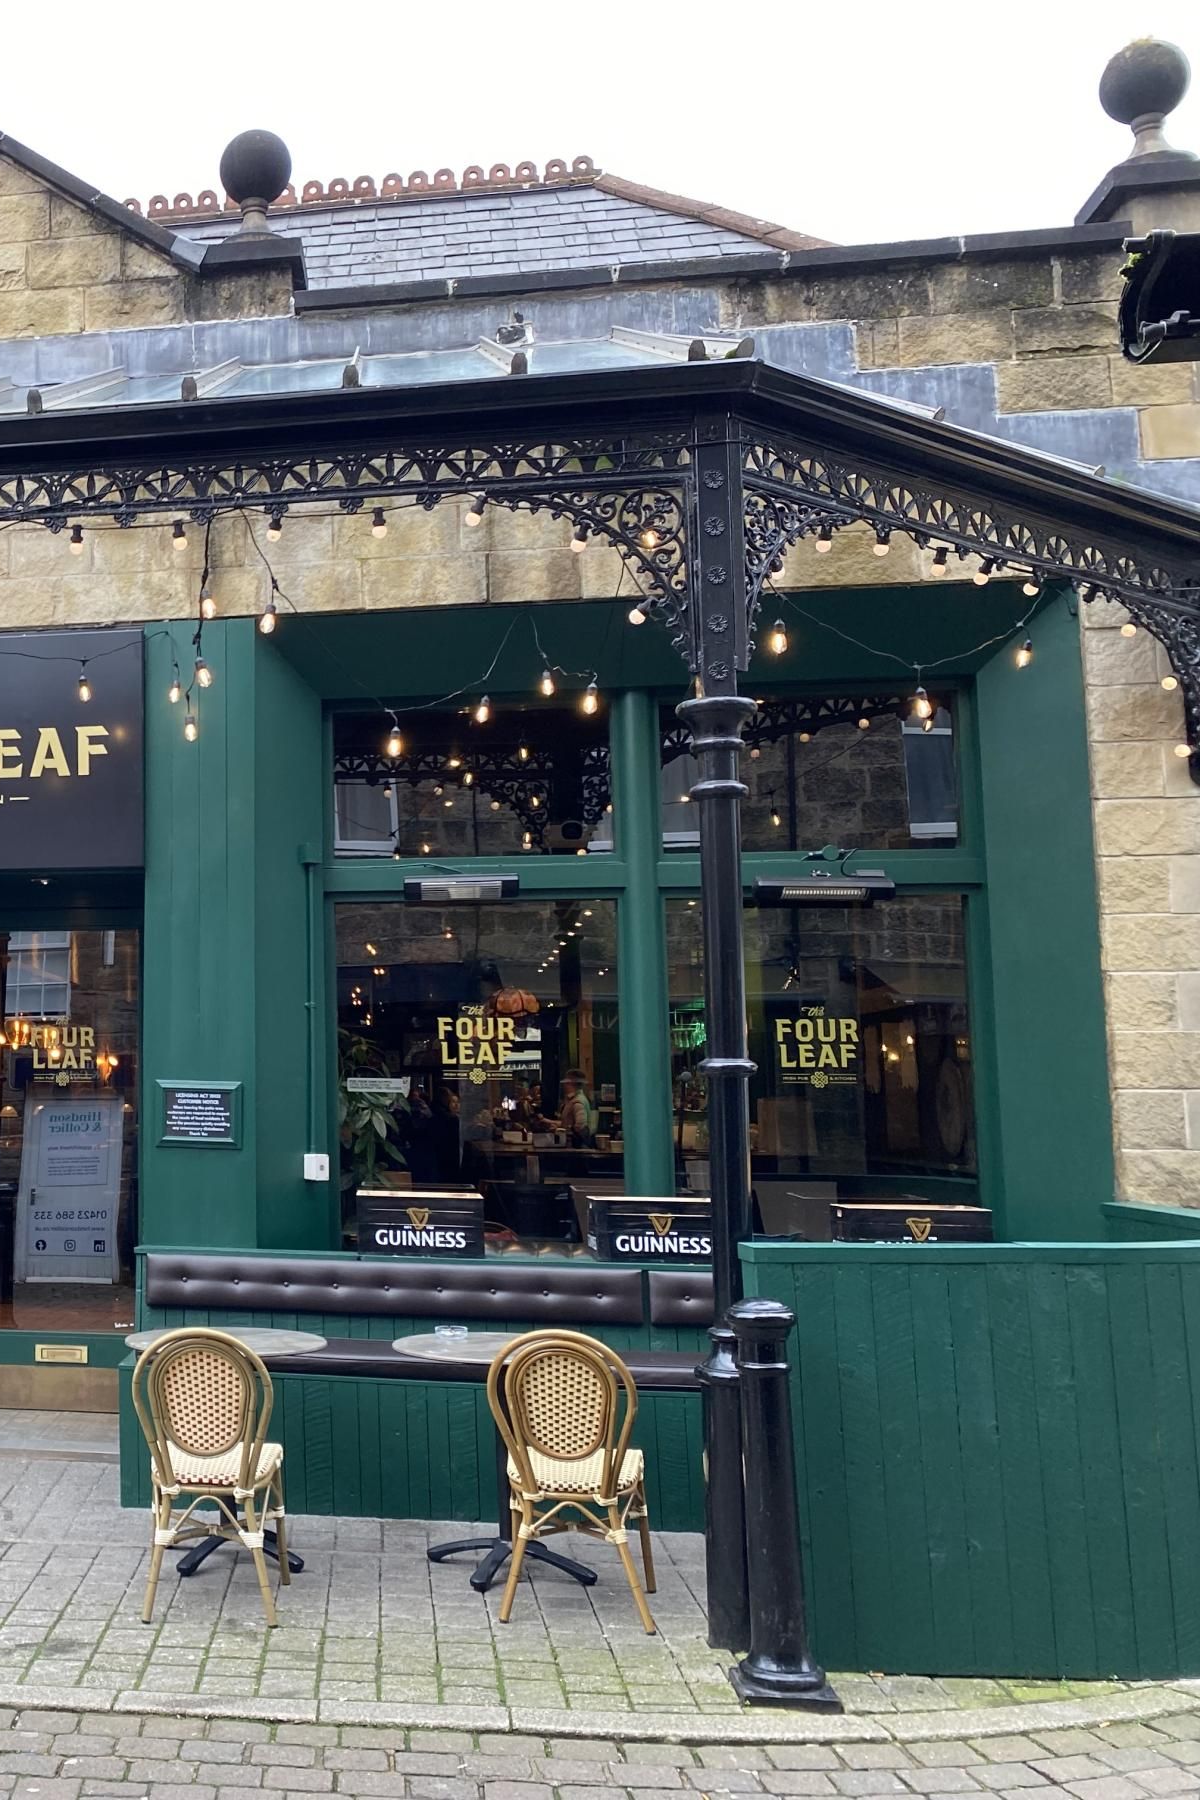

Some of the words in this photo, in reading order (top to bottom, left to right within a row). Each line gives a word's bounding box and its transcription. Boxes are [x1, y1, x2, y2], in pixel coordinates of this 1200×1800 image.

[437, 1017, 516, 1040] FOUR
[775, 1018, 859, 1042] FOUR
[441, 1041, 513, 1065] LEAF
[779, 1043, 857, 1068] LEAF
[375, 1229, 467, 1248] GUINNESS
[615, 1235, 712, 1255] GUINNESS
